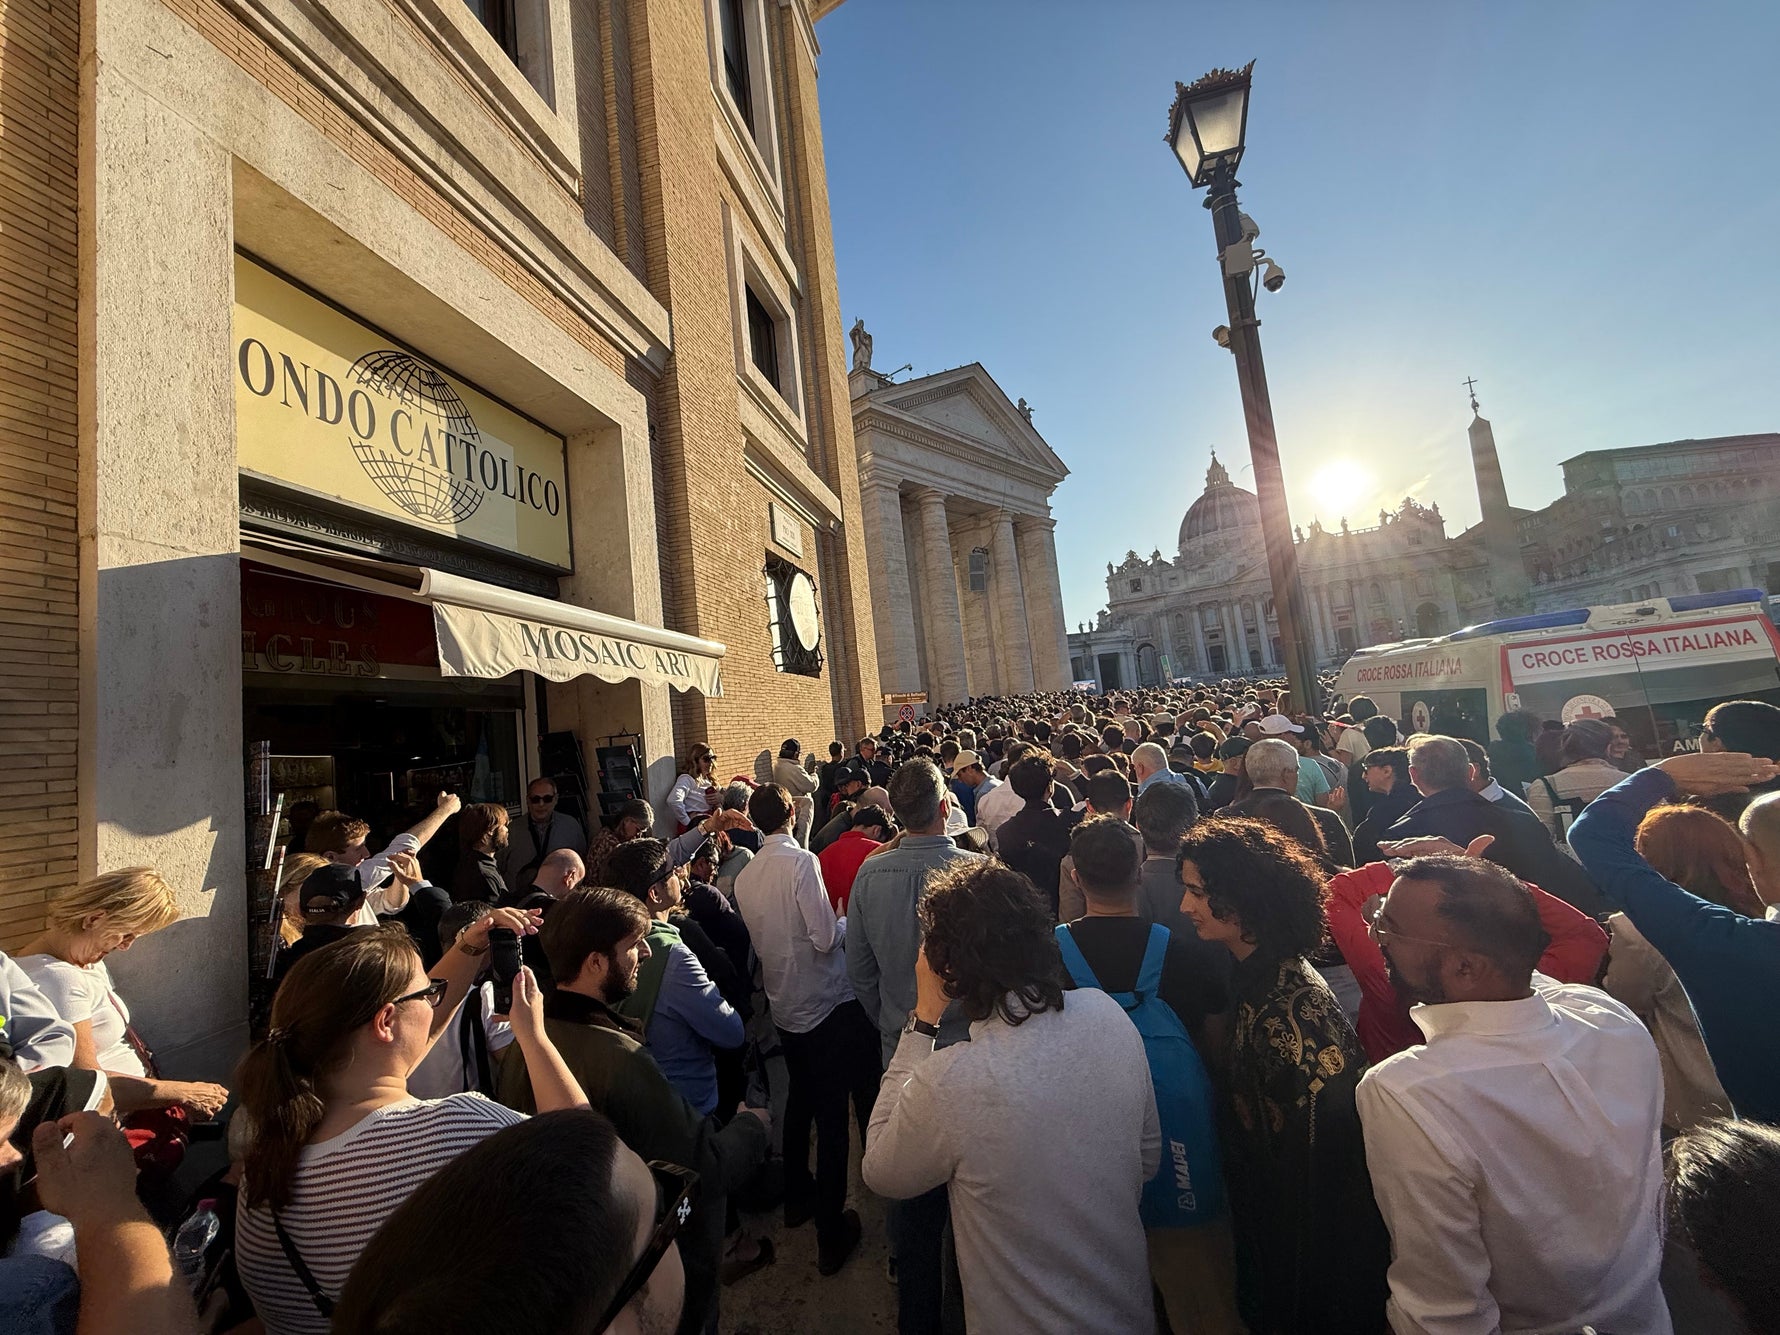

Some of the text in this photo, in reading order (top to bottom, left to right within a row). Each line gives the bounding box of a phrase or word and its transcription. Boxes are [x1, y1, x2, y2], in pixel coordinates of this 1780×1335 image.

[238, 337, 560, 517] ONDO CATTOLICO
[242, 630, 381, 677] ICLES
[517, 622, 692, 678] MOSAIC ART
[1357, 657, 1463, 682] CROCE ROSSA ITALIANA
[1521, 628, 1758, 669] CROCE ROSSA ITALIANA
[1673, 739, 1700, 752] AM
[1170, 1139, 1192, 1190] MAPEI
